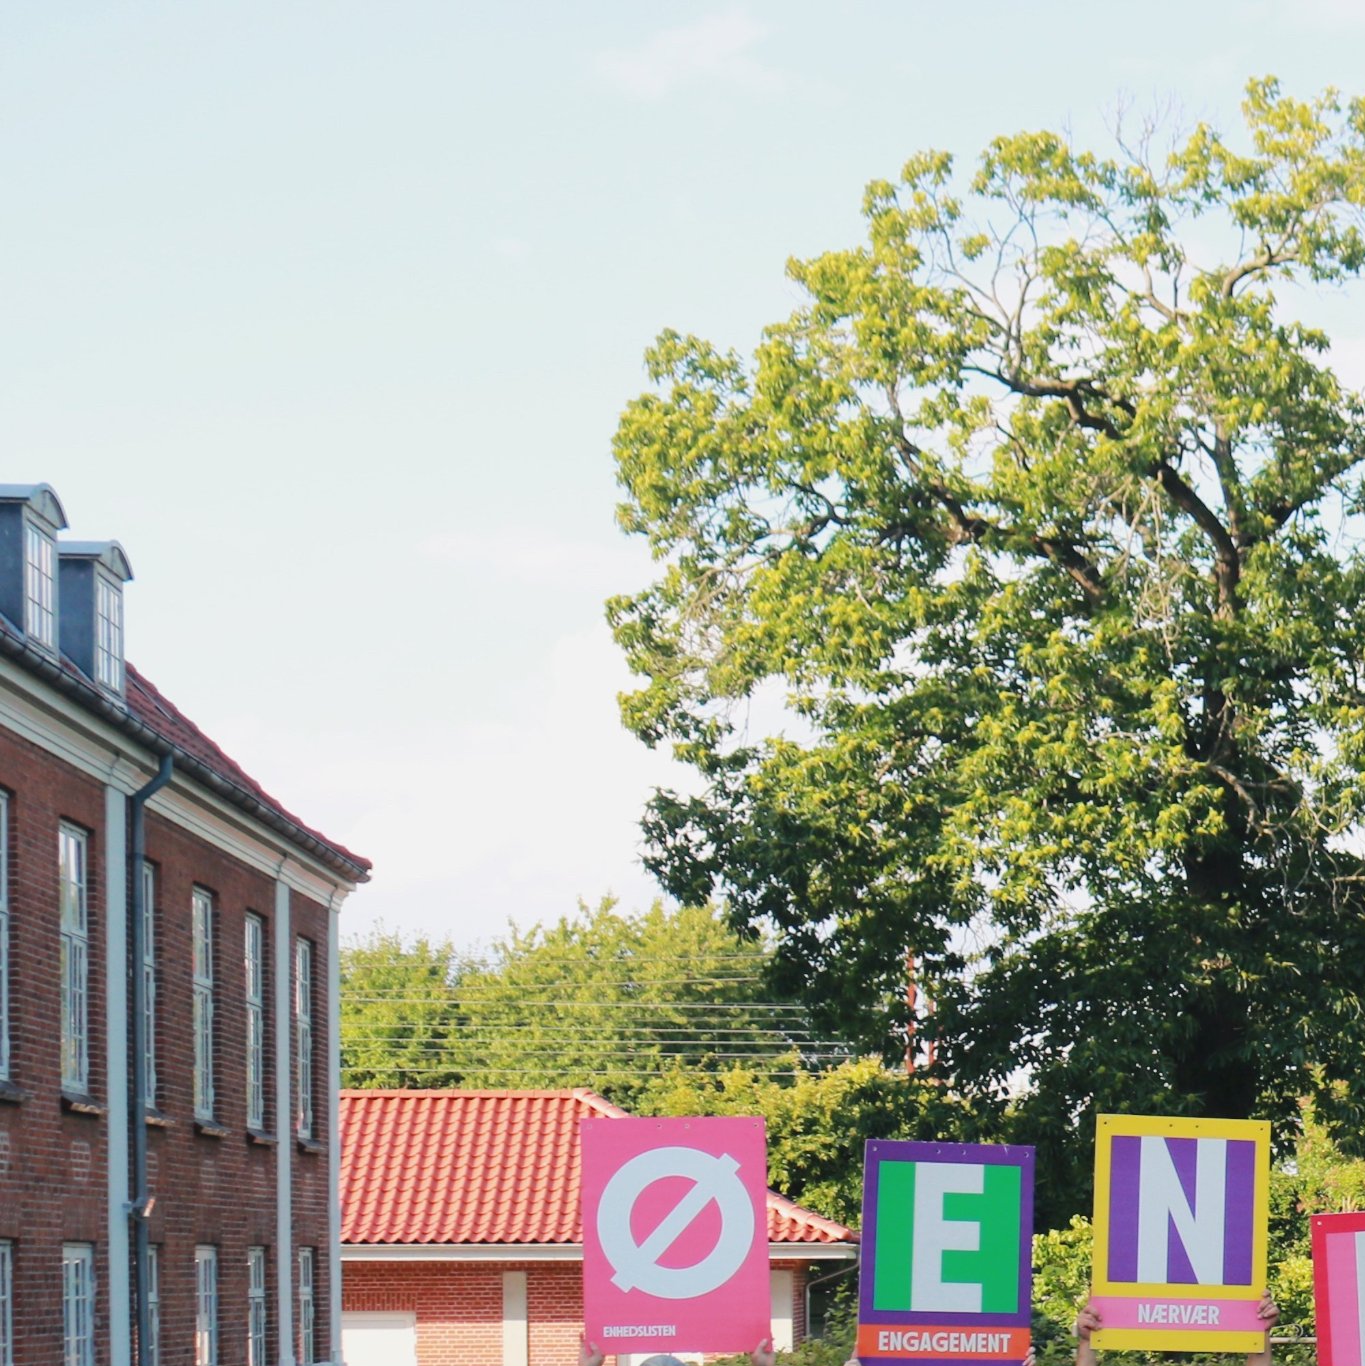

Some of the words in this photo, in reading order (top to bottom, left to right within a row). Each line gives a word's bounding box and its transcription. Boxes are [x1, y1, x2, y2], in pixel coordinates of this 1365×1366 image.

[596, 1146, 755, 1300] Ø
[910, 1162, 984, 1313] E
[1137, 1136, 1226, 1285] N
[604, 1325, 675, 1337] ENHEDSLISTEN
[879, 1331, 1011, 1352] ENGAGEMENT
[1139, 1304, 1219, 1324] NÆRVÆR
